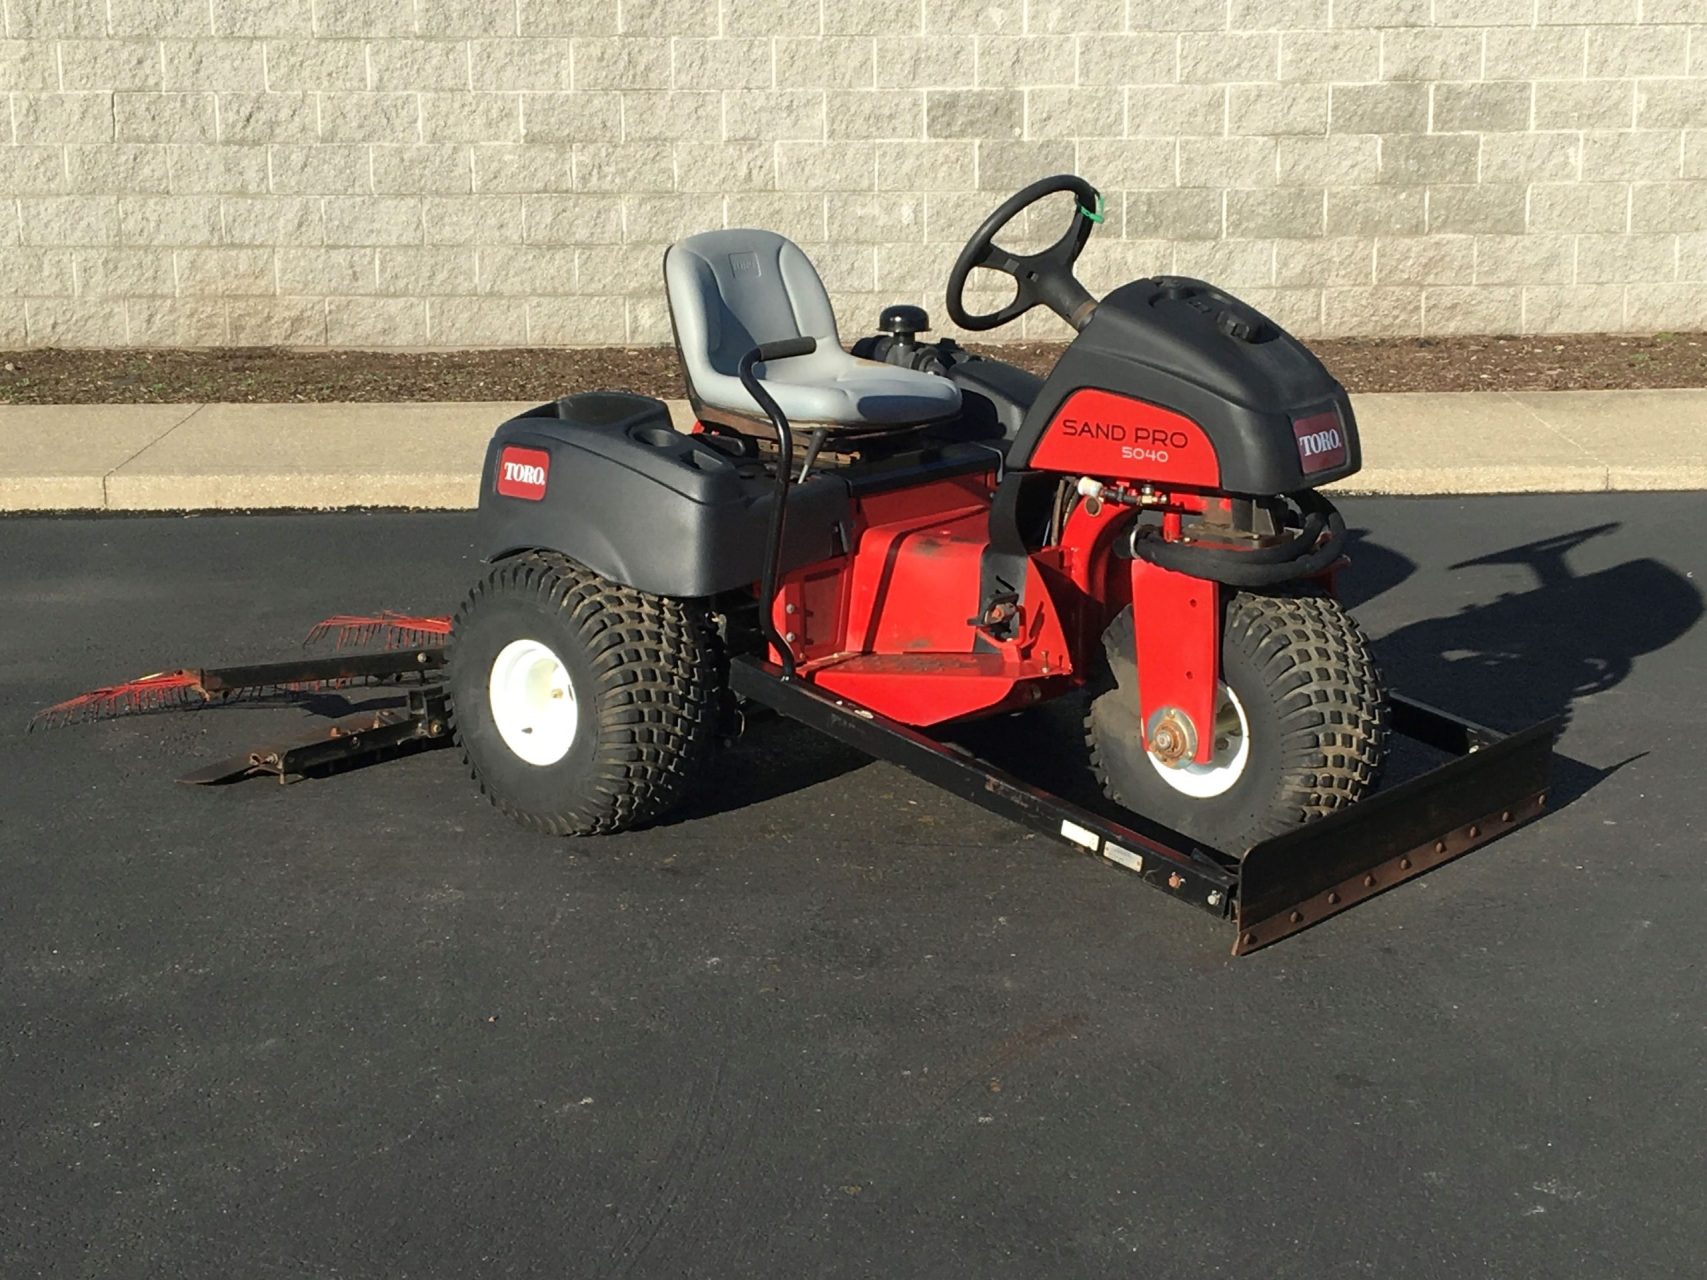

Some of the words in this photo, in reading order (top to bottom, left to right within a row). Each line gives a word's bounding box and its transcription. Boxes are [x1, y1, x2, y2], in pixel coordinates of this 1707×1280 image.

[1062, 419, 1126, 442] SAND
[1134, 427, 1189, 449] PRO
[1121, 446, 1169, 463] 5040
